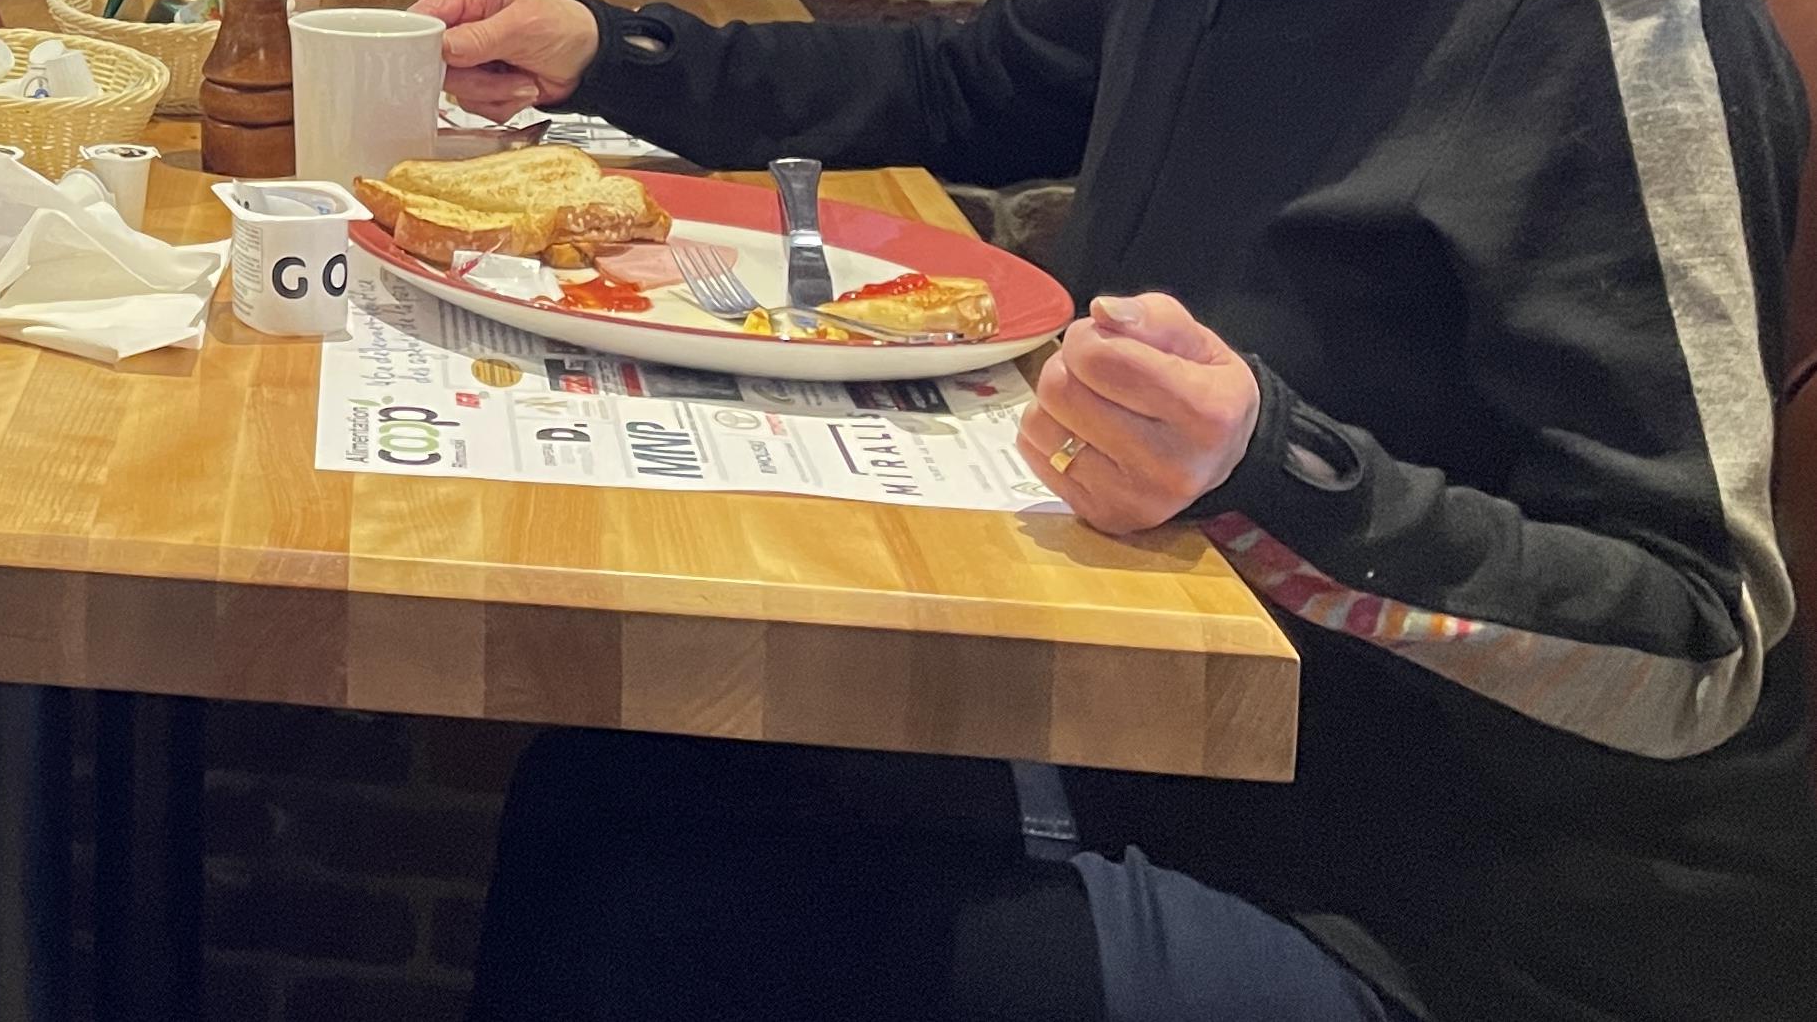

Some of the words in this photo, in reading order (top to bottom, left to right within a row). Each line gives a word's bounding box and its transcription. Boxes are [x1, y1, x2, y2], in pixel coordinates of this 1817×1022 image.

[345, 406, 370, 464] Alimentation
[626, 421, 704, 479] MNP
[846, 412, 923, 497] MIRALIS
